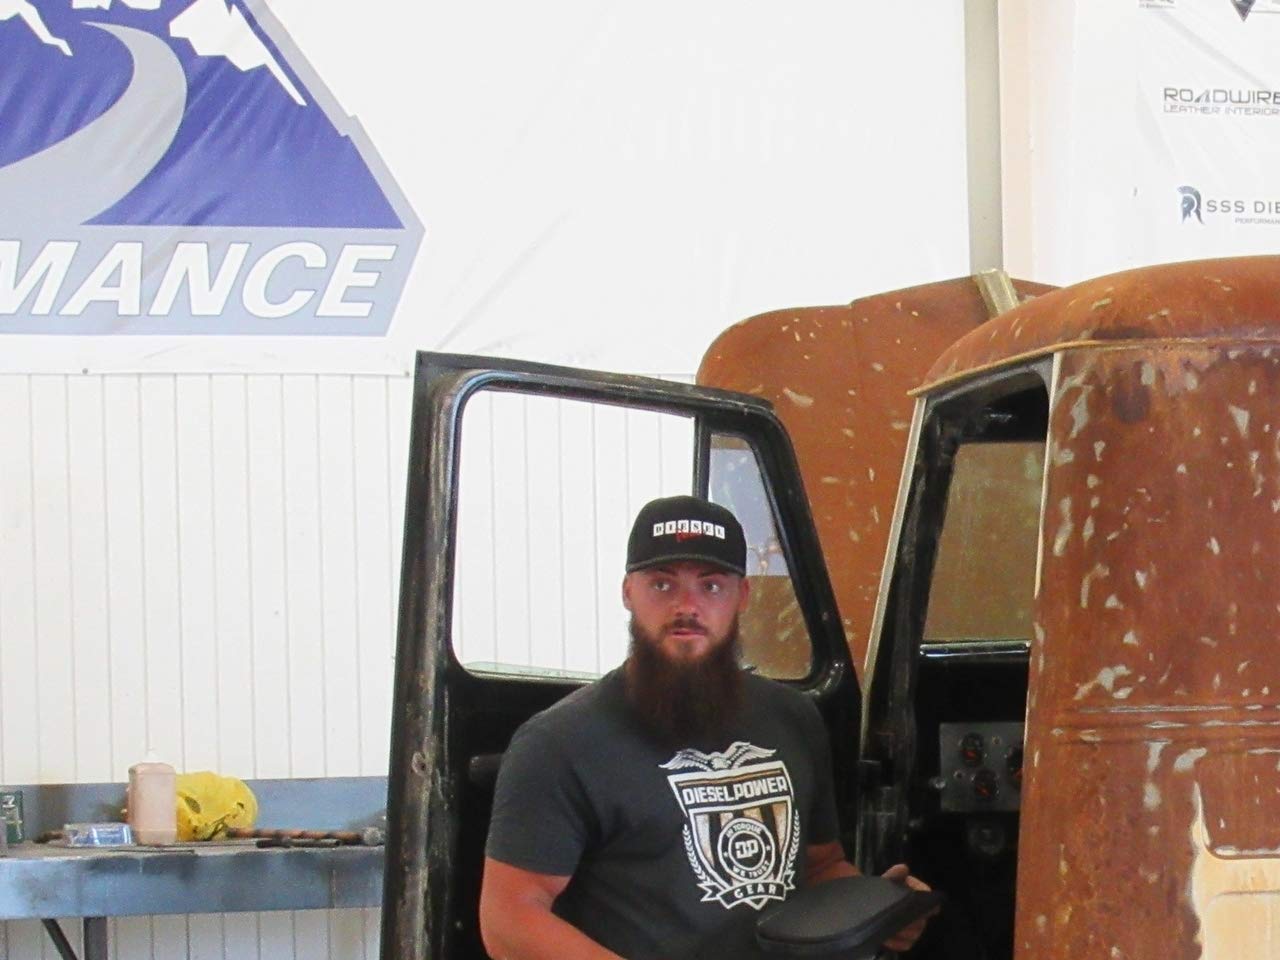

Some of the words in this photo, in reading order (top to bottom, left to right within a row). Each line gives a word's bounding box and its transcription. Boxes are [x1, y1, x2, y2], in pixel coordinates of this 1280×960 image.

[1163, 104, 1219, 114] LEATHER
[1206, 200, 1245, 213] SSS
[653, 520, 725, 539] DIESEL
[682, 785, 732, 805] DIESEL
[733, 776, 788, 801] POWER
[749, 861, 771, 879] TRUST
[734, 883, 777, 899] GEAR
